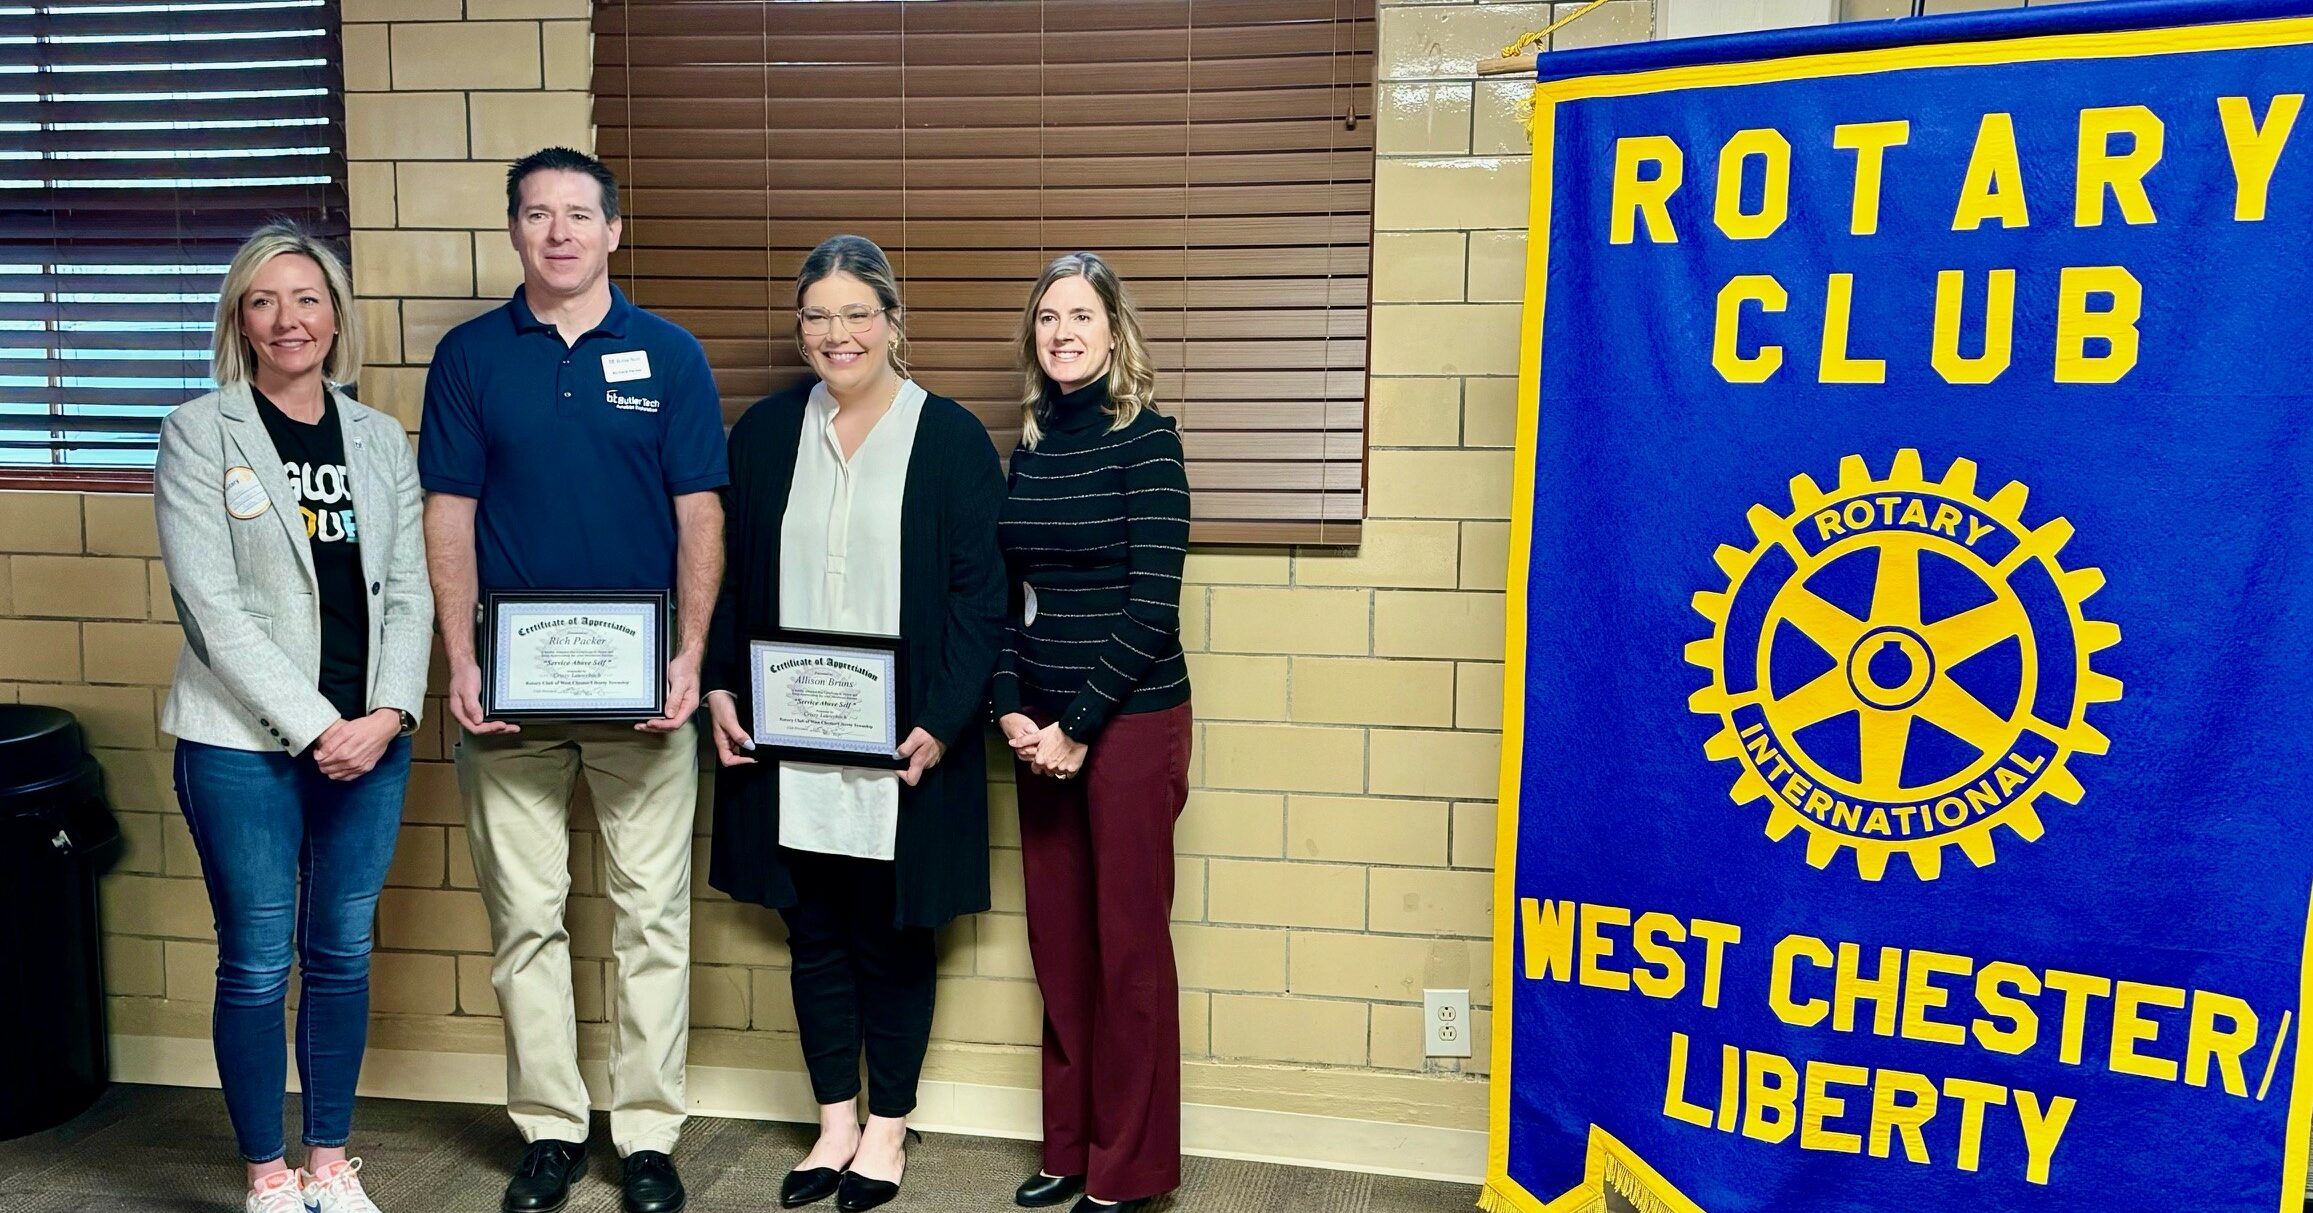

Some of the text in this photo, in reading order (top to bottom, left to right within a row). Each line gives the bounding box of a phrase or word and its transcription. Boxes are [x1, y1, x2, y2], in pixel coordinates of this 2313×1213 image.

[1610, 94, 2304, 244] ROTARY
[1711, 265, 2143, 384] CLUB
[1815, 496, 1996, 547] ROTARY
[518, 617, 636, 637] Certificate of Appreciation
[549, 636, 607, 645] Rich Packer
[770, 657, 878, 682] Certificate of Appreciation
[795, 675, 825, 685] Allison
[1741, 722, 2045, 836] INTERNATIONAL
[1520, 897, 1741, 1009] WEST
[1662, 1032, 2078, 1186] LIBERTY
